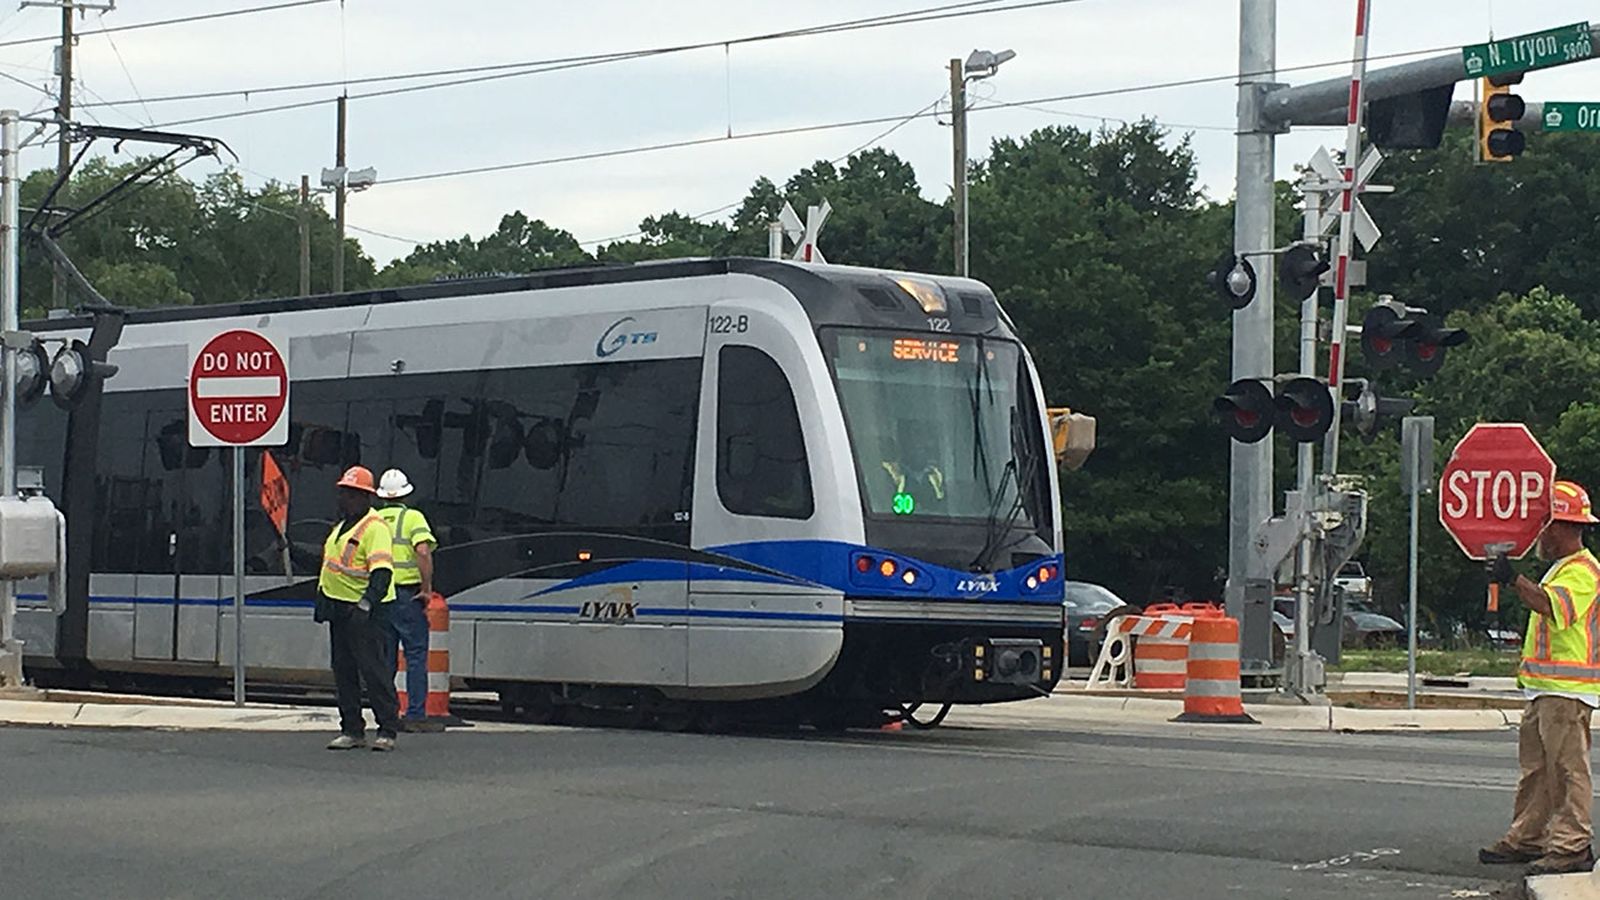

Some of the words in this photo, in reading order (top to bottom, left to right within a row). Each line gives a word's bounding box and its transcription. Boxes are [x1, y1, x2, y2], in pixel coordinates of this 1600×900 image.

[1488, 43, 1506, 67] N.
[1511, 35, 1557, 66] Tryon
[1563, 40, 1591, 60] 5800
[709, 315, 749, 334] 122-B
[927, 317, 951, 332] 122
[893, 338, 960, 363] SERVICE
[203, 352, 229, 371] DO
[236, 351, 274, 371] NOT
[210, 404, 267, 423] ENTER
[893, 494, 914, 513] 30
[1445, 469, 1545, 520] STOP
[956, 579, 1001, 592] LYNX
[579, 601, 639, 619] LYNX
